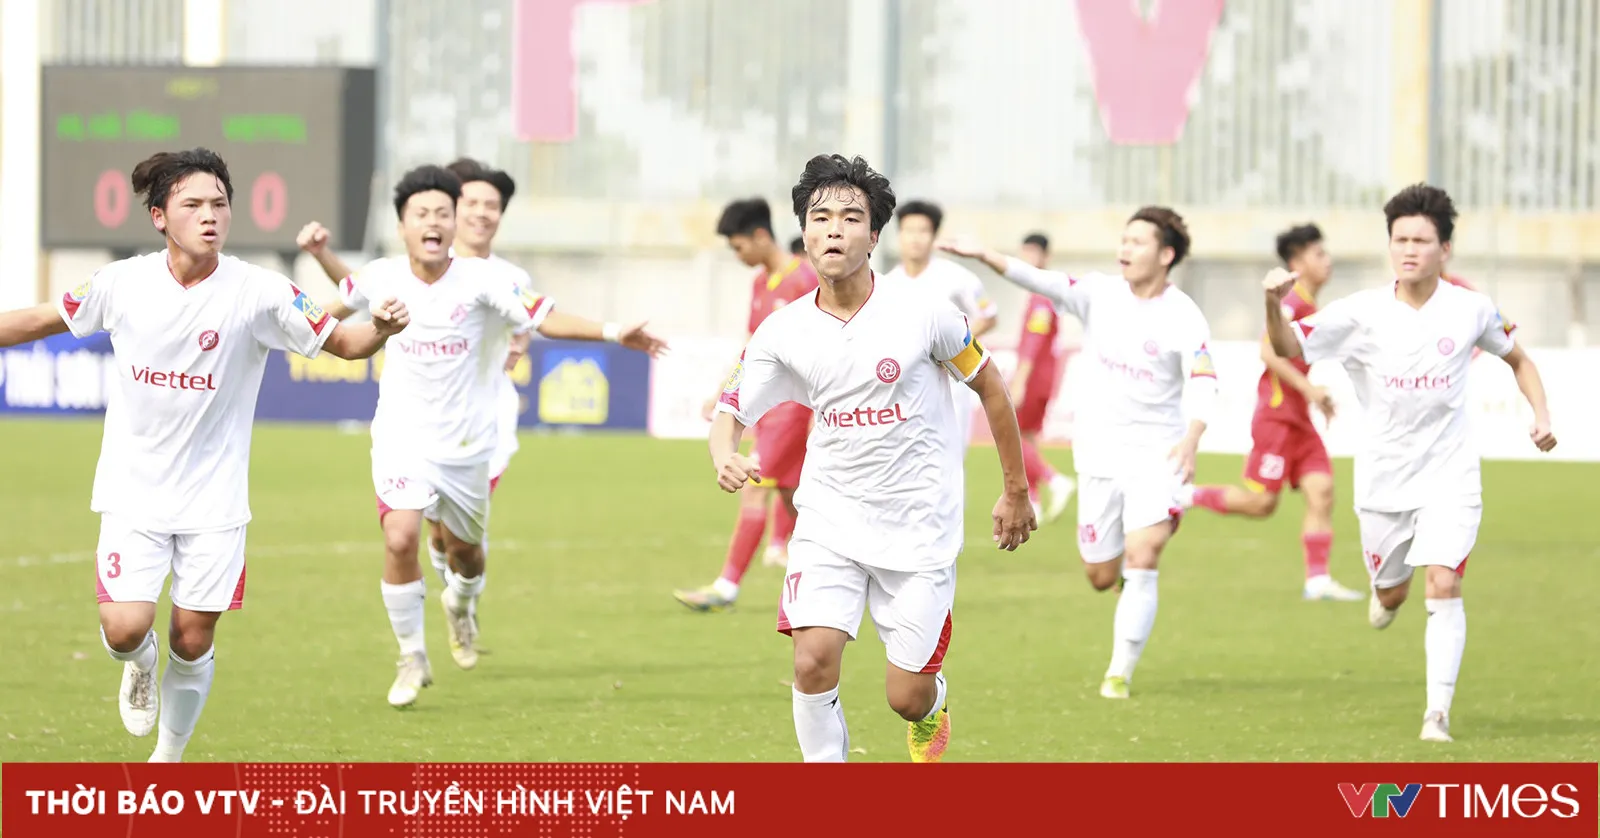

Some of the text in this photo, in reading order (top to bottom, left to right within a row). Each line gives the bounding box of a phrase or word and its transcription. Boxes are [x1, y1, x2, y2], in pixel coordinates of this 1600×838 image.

[94, 169, 130, 230] 0
[251, 171, 287, 231] 0
[131, 364, 216, 391] viettel
[821, 403, 907, 429] viettel
[107, 552, 122, 579] 3
[785, 571, 802, 604] 17
